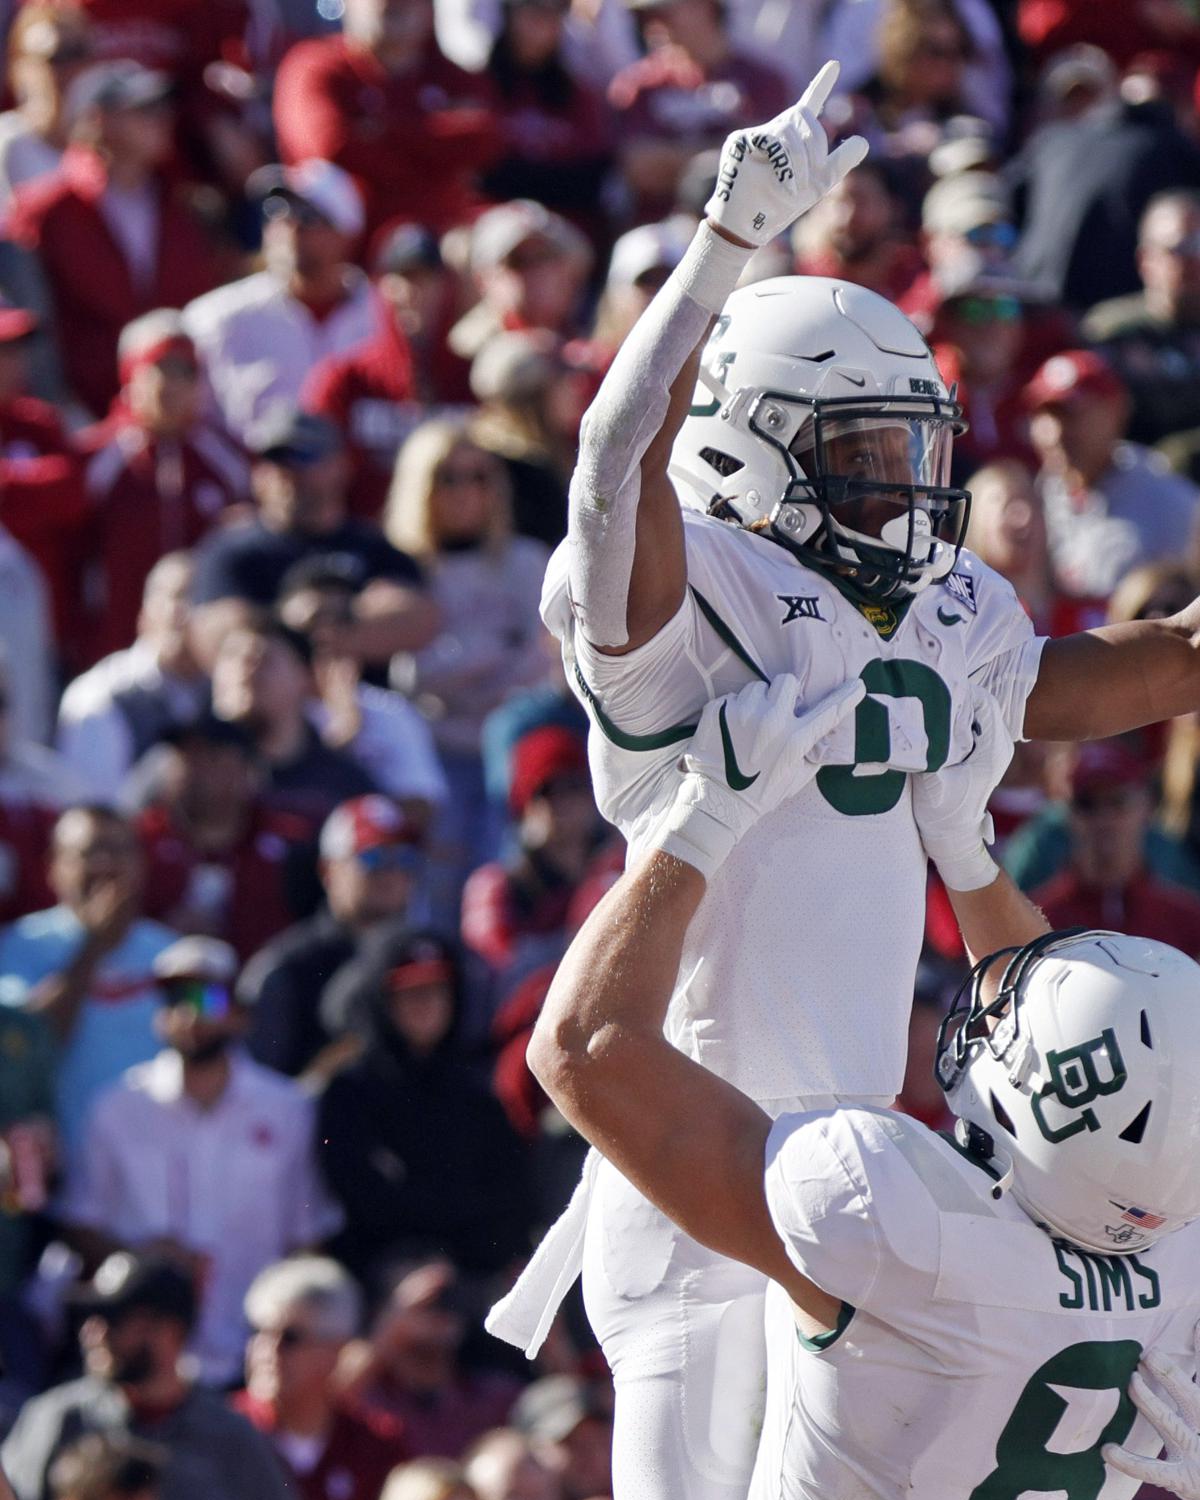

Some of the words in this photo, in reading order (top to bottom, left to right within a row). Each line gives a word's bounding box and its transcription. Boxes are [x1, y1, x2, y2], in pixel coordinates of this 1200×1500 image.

[717, 163, 738, 202] SIC
[777, 595, 828, 625] XII
[1031, 1027, 1128, 1144] BU
[1052, 1246, 1162, 1312] SIMS
